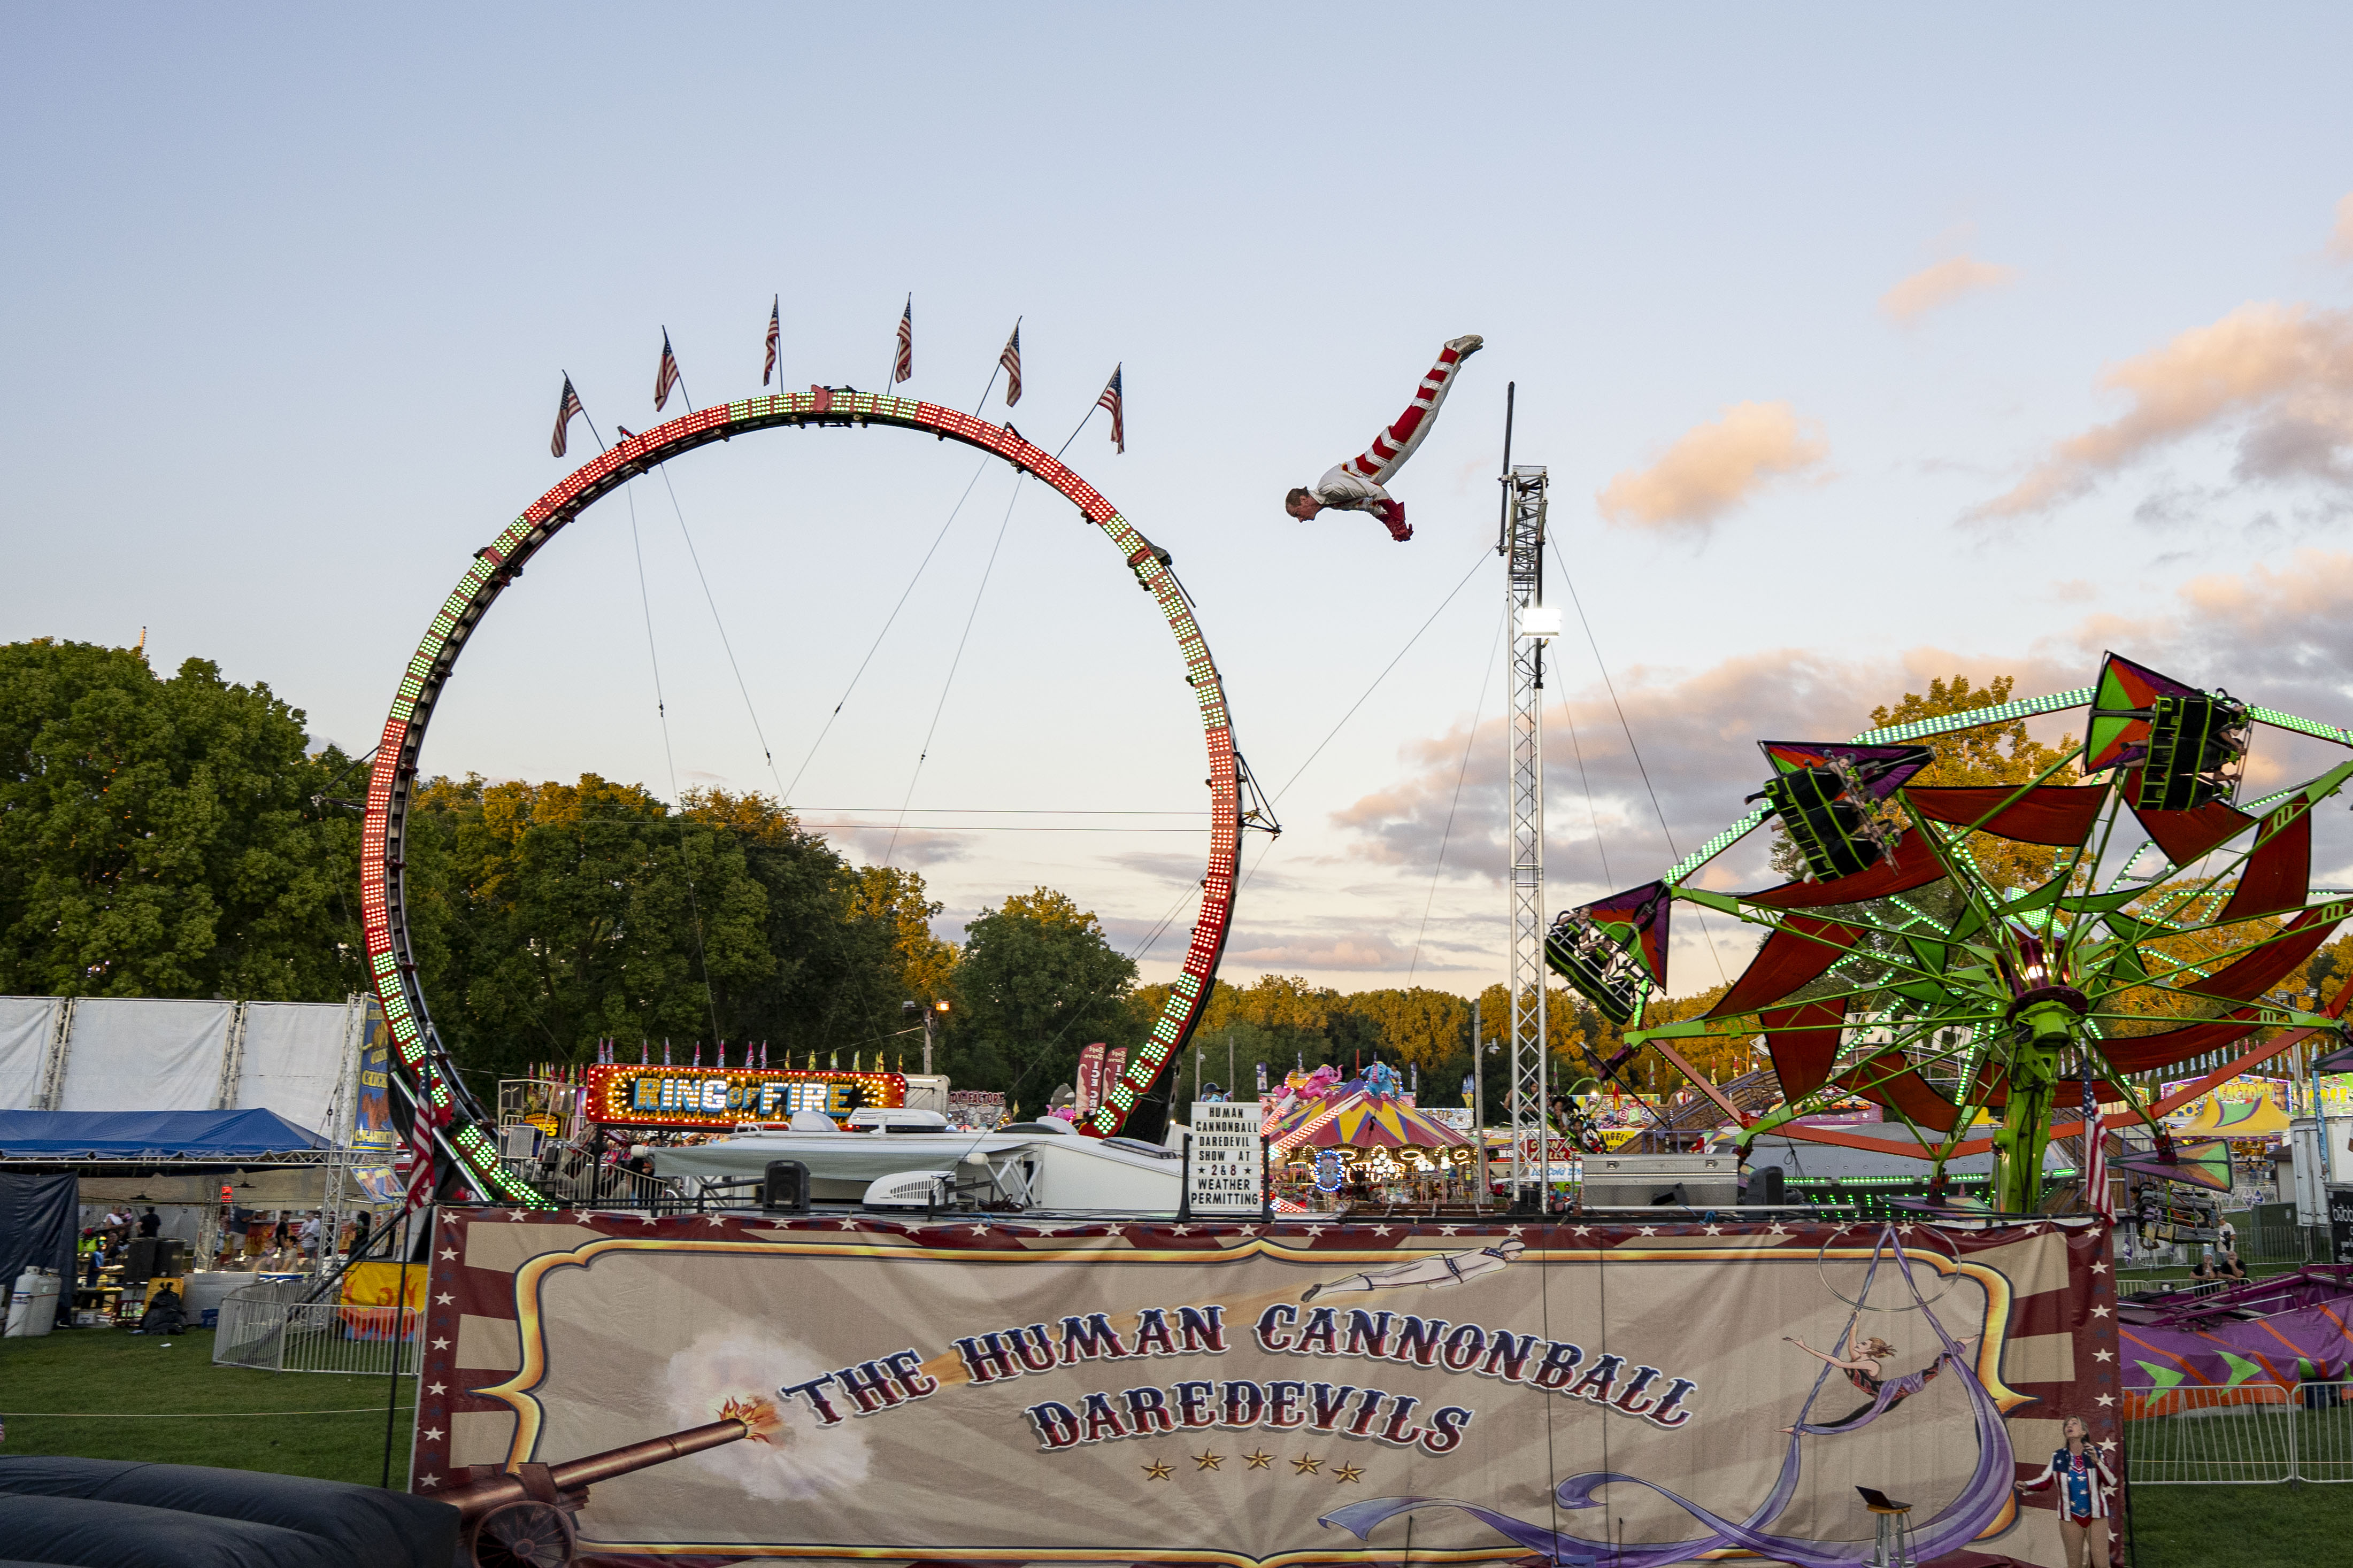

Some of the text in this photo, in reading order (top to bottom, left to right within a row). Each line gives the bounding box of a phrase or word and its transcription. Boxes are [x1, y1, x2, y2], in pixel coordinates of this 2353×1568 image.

[634, 1077, 854, 1116] RING OF FIRE
[968, 1092, 1005, 1104] FACTORY
[1210, 1107, 1243, 1118] HUMAN
[1199, 1137, 1250, 1147] DAREDEVIL
[1199, 1151, 1250, 1161] SHOW AT
[1198, 1179, 1250, 1190] WEATHER
[1191, 1193, 1258, 1204] PERMITTING
[781, 1302, 1697, 1428] THE HUMAN CANNONBALL
[1025, 1379, 1474, 1454] DAREDEVILS
